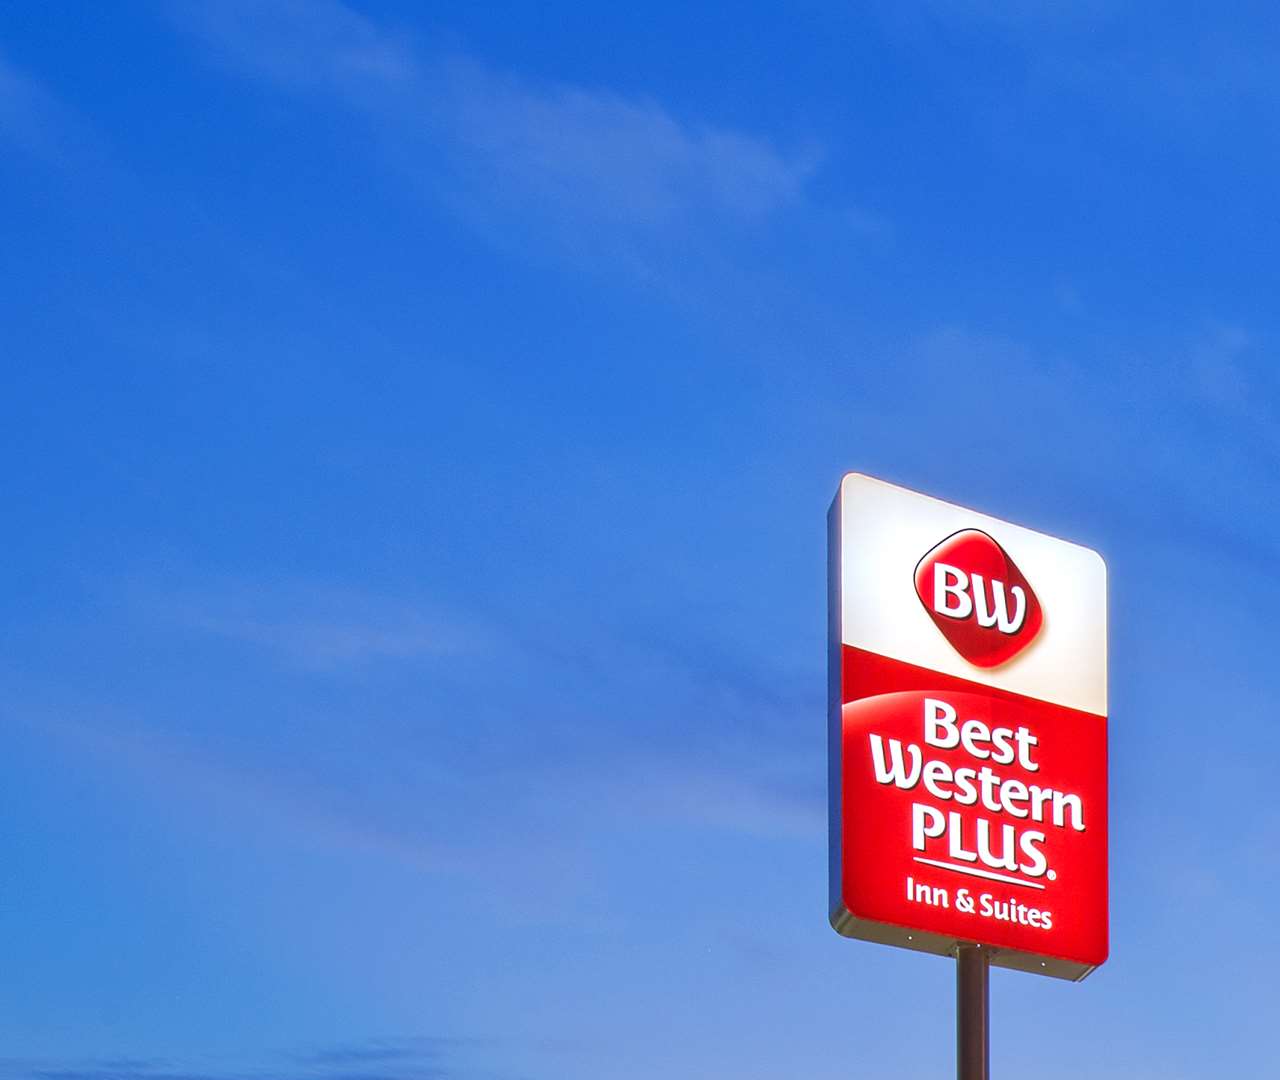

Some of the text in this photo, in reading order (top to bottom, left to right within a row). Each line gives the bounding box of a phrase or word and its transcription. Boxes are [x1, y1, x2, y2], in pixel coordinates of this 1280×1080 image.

[934, 562, 1026, 635] BW
[924, 698, 1038, 772] Best
[869, 733, 1086, 831] Western
[906, 877, 1053, 930] Inn & Suites
